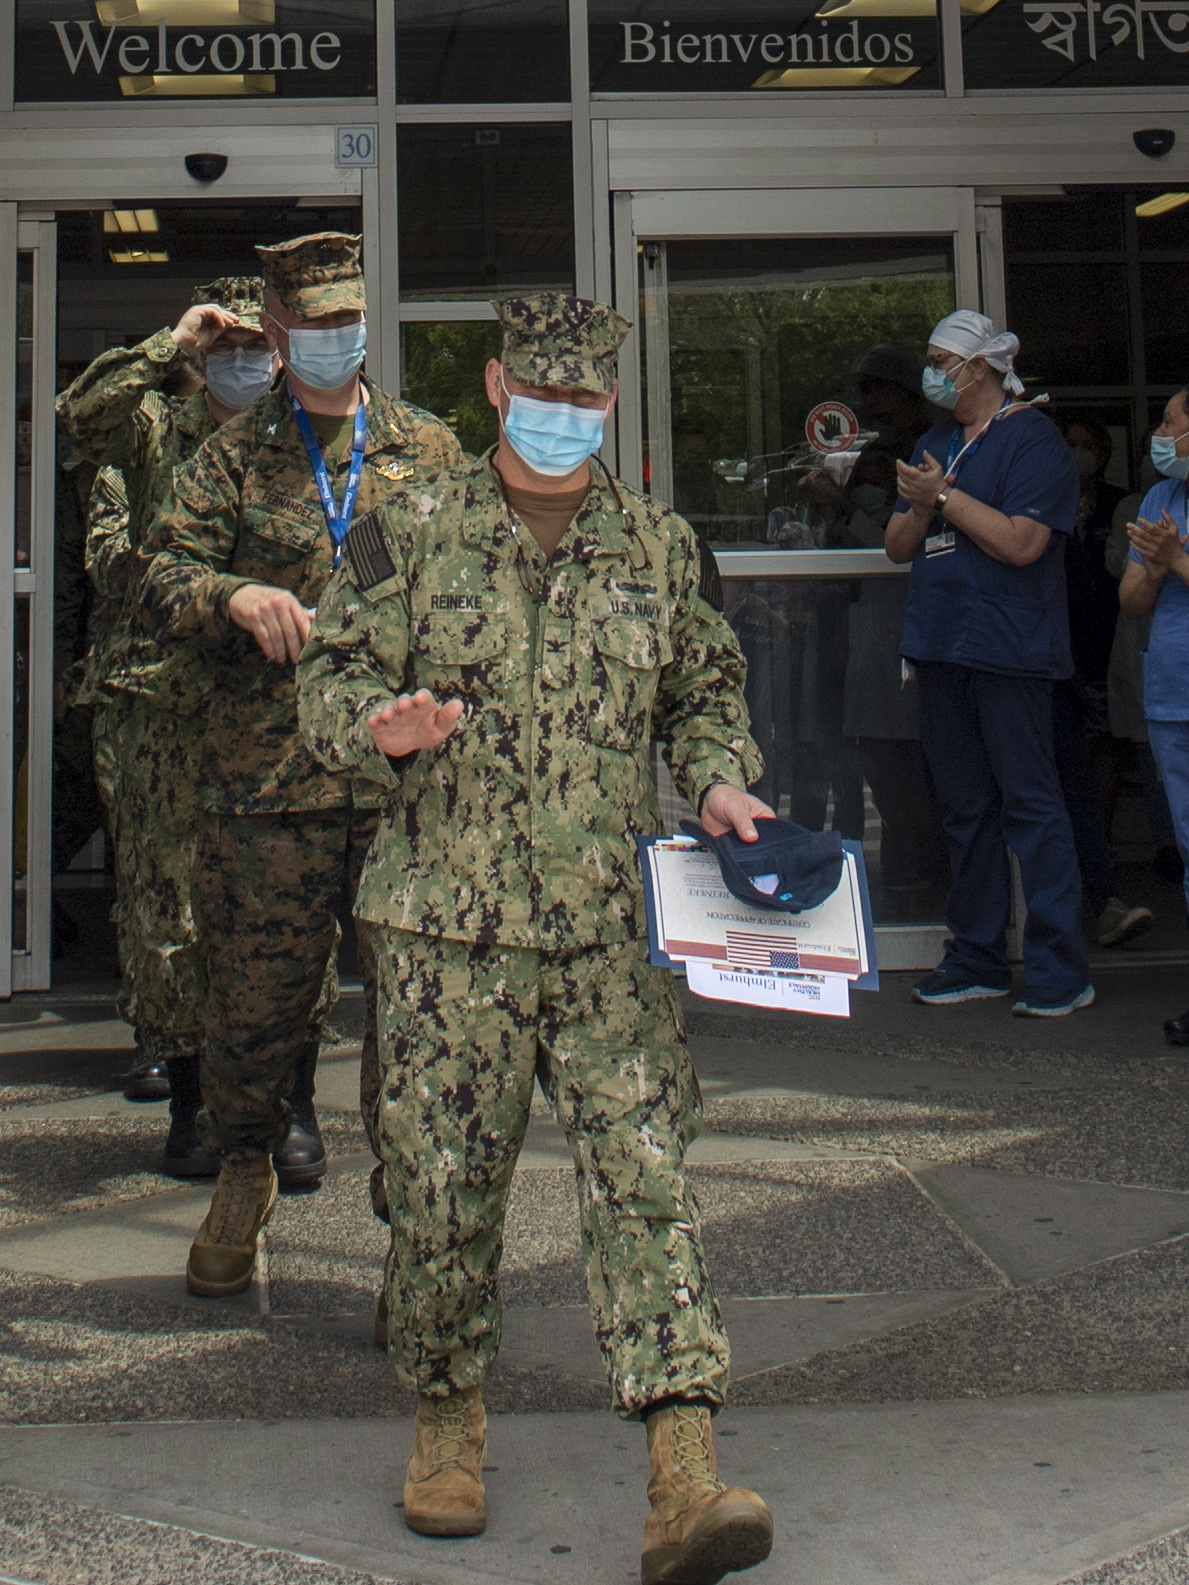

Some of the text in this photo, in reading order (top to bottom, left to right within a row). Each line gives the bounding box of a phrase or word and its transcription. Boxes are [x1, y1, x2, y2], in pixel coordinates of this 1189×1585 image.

[50, 17, 342, 75] Welcome
[619, 20, 914, 64] Bienvenidos
[341, 133, 371, 159] 30
[261, 492, 316, 519] FERNANDEZ
[430, 594, 482, 610] REINEKE
[610, 600, 662, 619] U.S. NAVY
[706, 911, 755, 924] APPRECIATION
[766, 917, 811, 928] CERTIFICATE
[718, 972, 777, 991] Elmhurst
